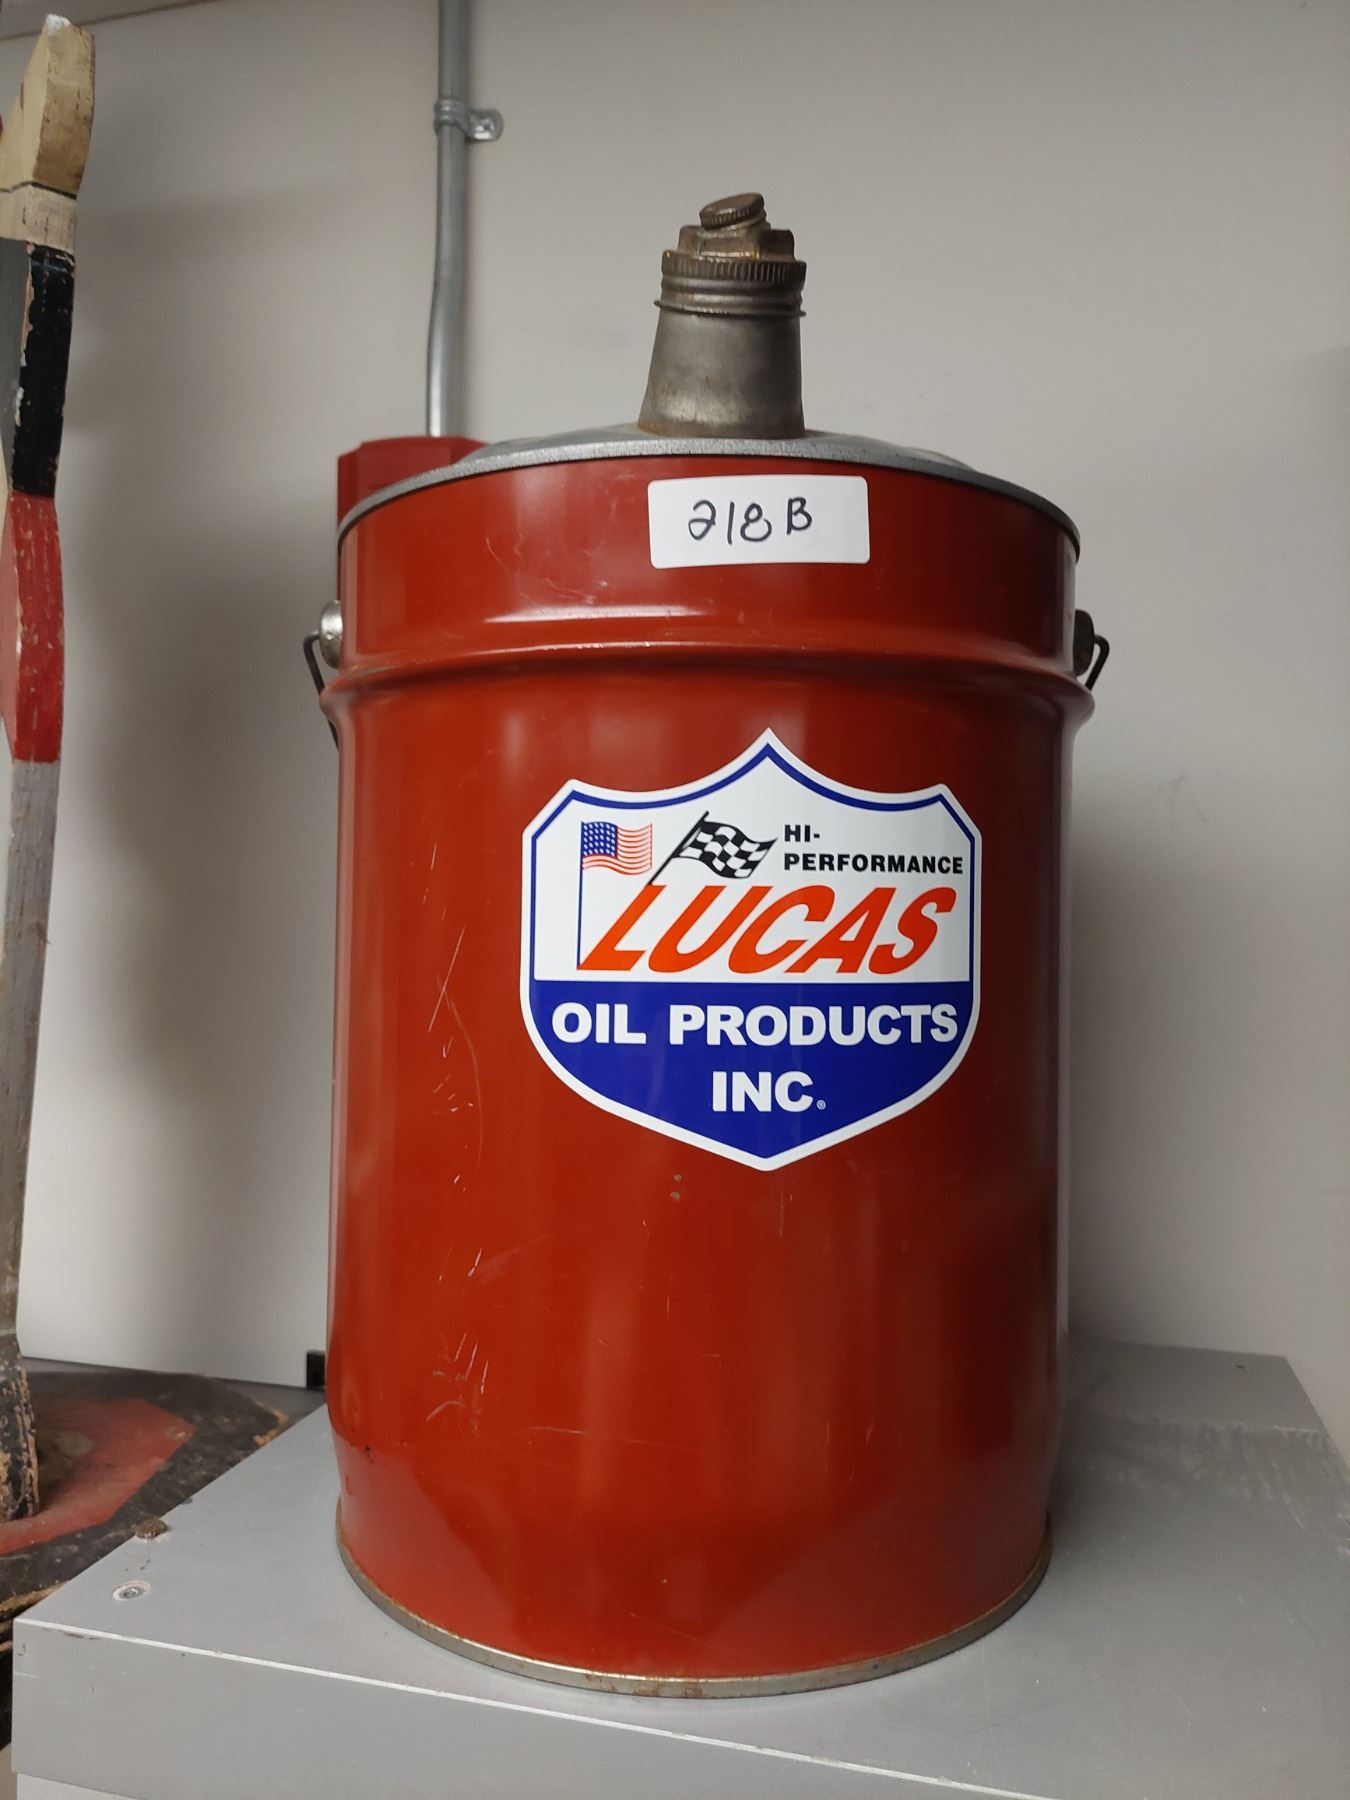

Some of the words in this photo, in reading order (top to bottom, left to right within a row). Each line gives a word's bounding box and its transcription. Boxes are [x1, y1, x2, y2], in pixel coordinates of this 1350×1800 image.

[783, 824, 821, 843] HI-
[783, 853, 964, 875] PERFORMANCE
[576, 884, 957, 975] LUCAS
[551, 1001, 646, 1045] OIL
[669, 1003, 959, 1046] PRODUCTS
